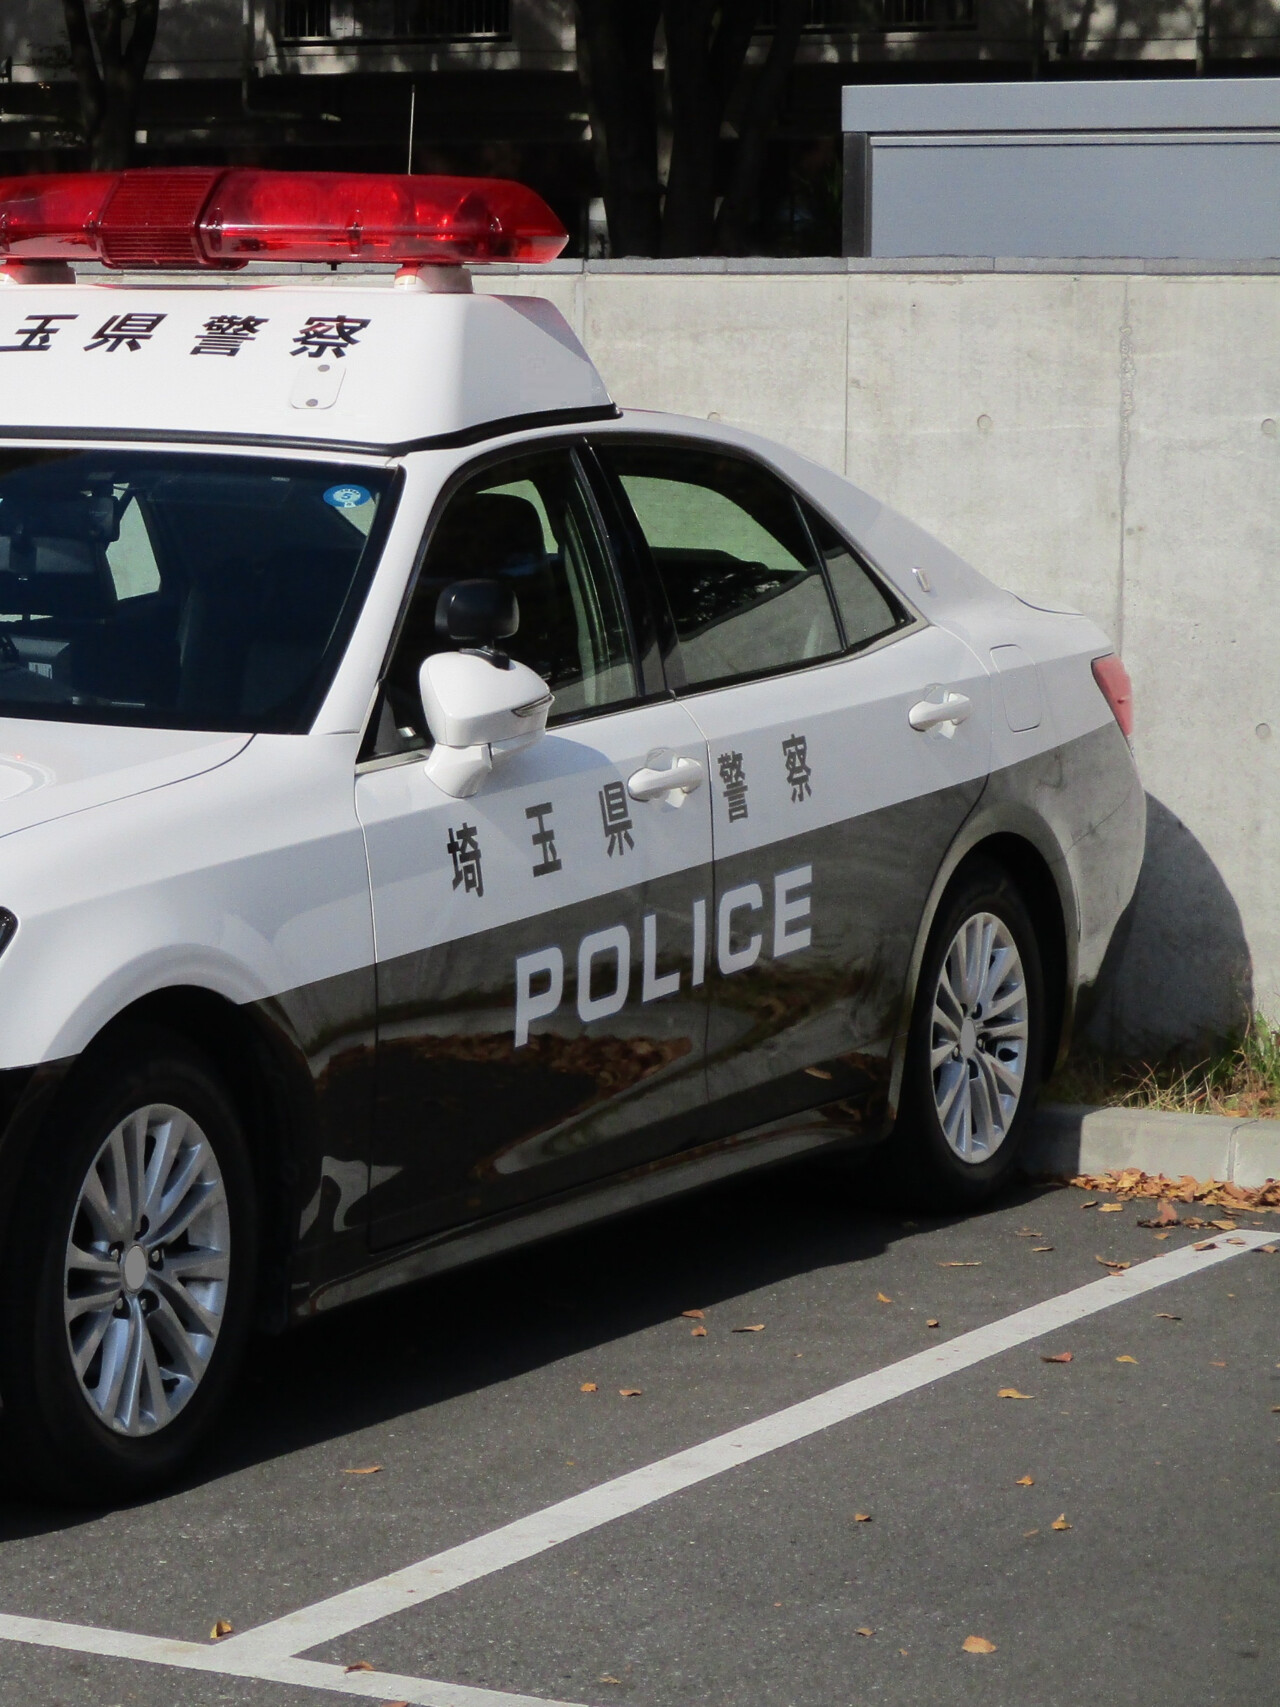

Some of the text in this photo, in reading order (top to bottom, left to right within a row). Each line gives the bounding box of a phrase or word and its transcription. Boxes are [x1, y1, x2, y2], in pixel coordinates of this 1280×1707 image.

[447, 734, 812, 898] 埼玉県警察
[515, 865, 813, 1048] POLICE
